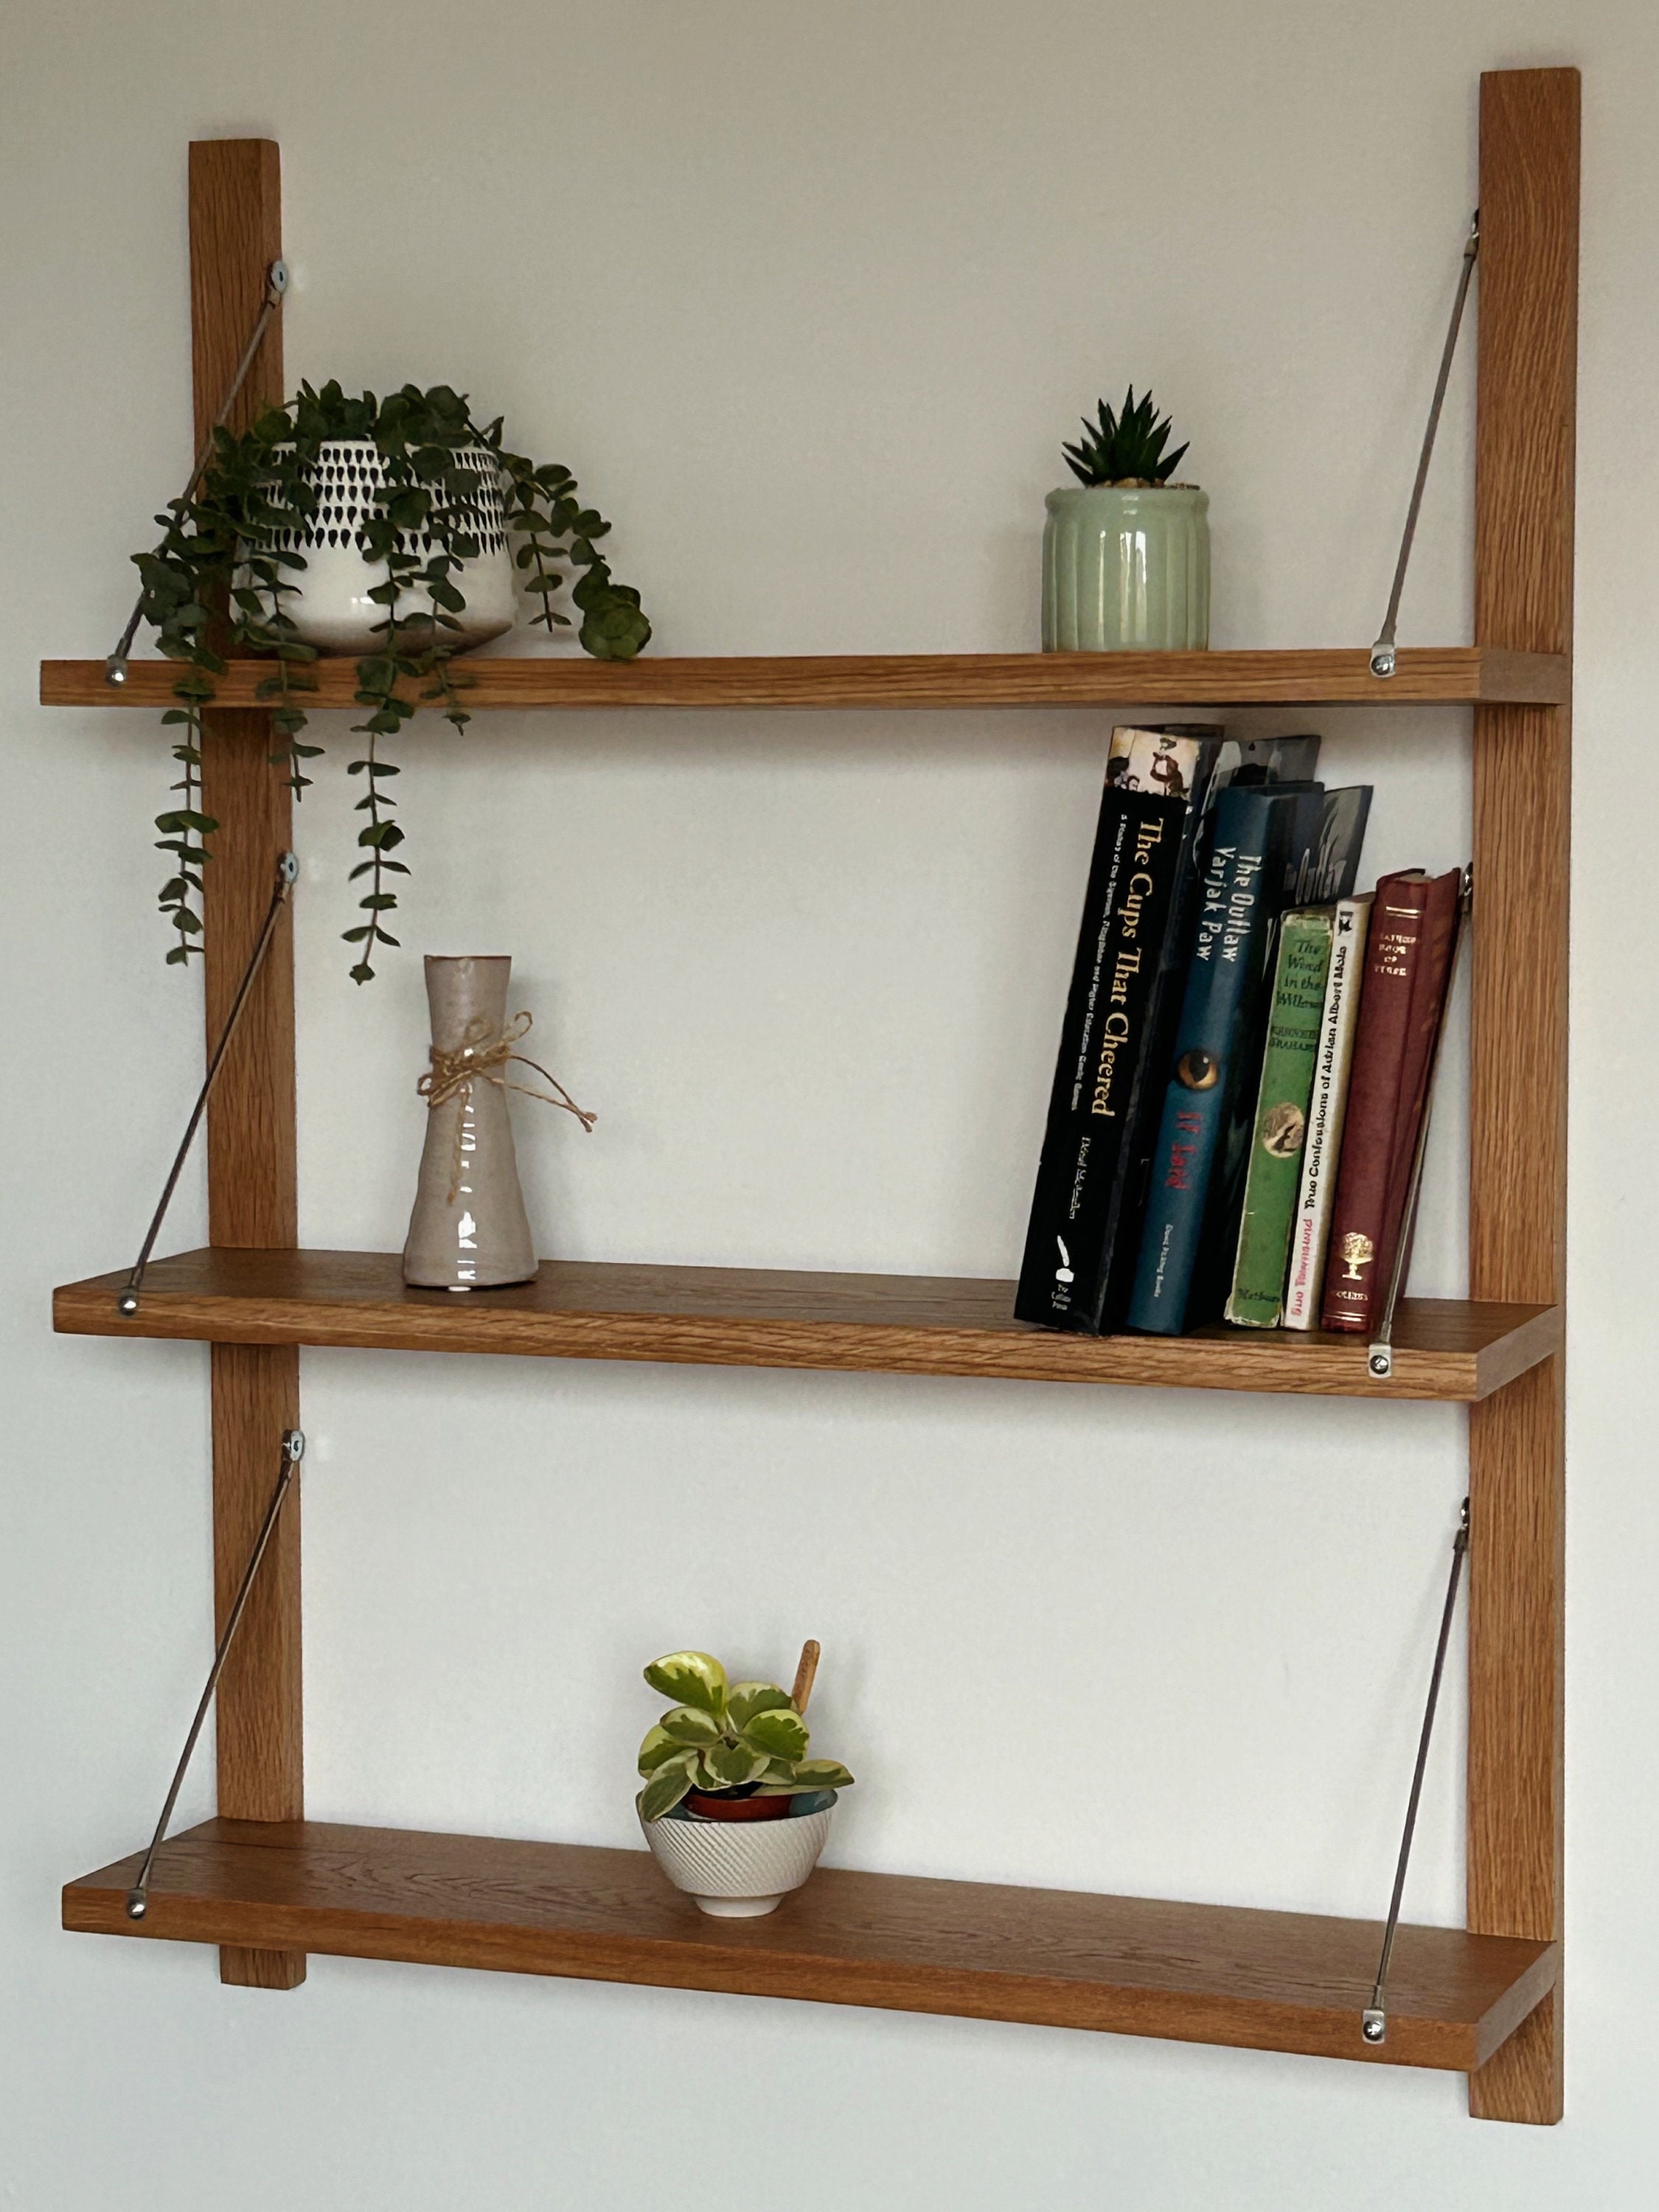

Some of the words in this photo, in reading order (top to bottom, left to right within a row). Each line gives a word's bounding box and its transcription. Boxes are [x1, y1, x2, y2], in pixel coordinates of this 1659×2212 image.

[1134, 818, 1164, 866] The
[1233, 855, 1263, 887] The
[1117, 872, 1153, 939] Cups
[1203, 846, 1237, 913] Varjak
[1196, 920, 1223, 961] Paw
[1222, 892, 1255, 962] Outlaw
[1110, 947, 1142, 1006] That
[1091, 1012, 1130, 1117] Cheered
[1304, 1180, 1318, 1211] True
[1322, 1074, 1331, 1090] of
